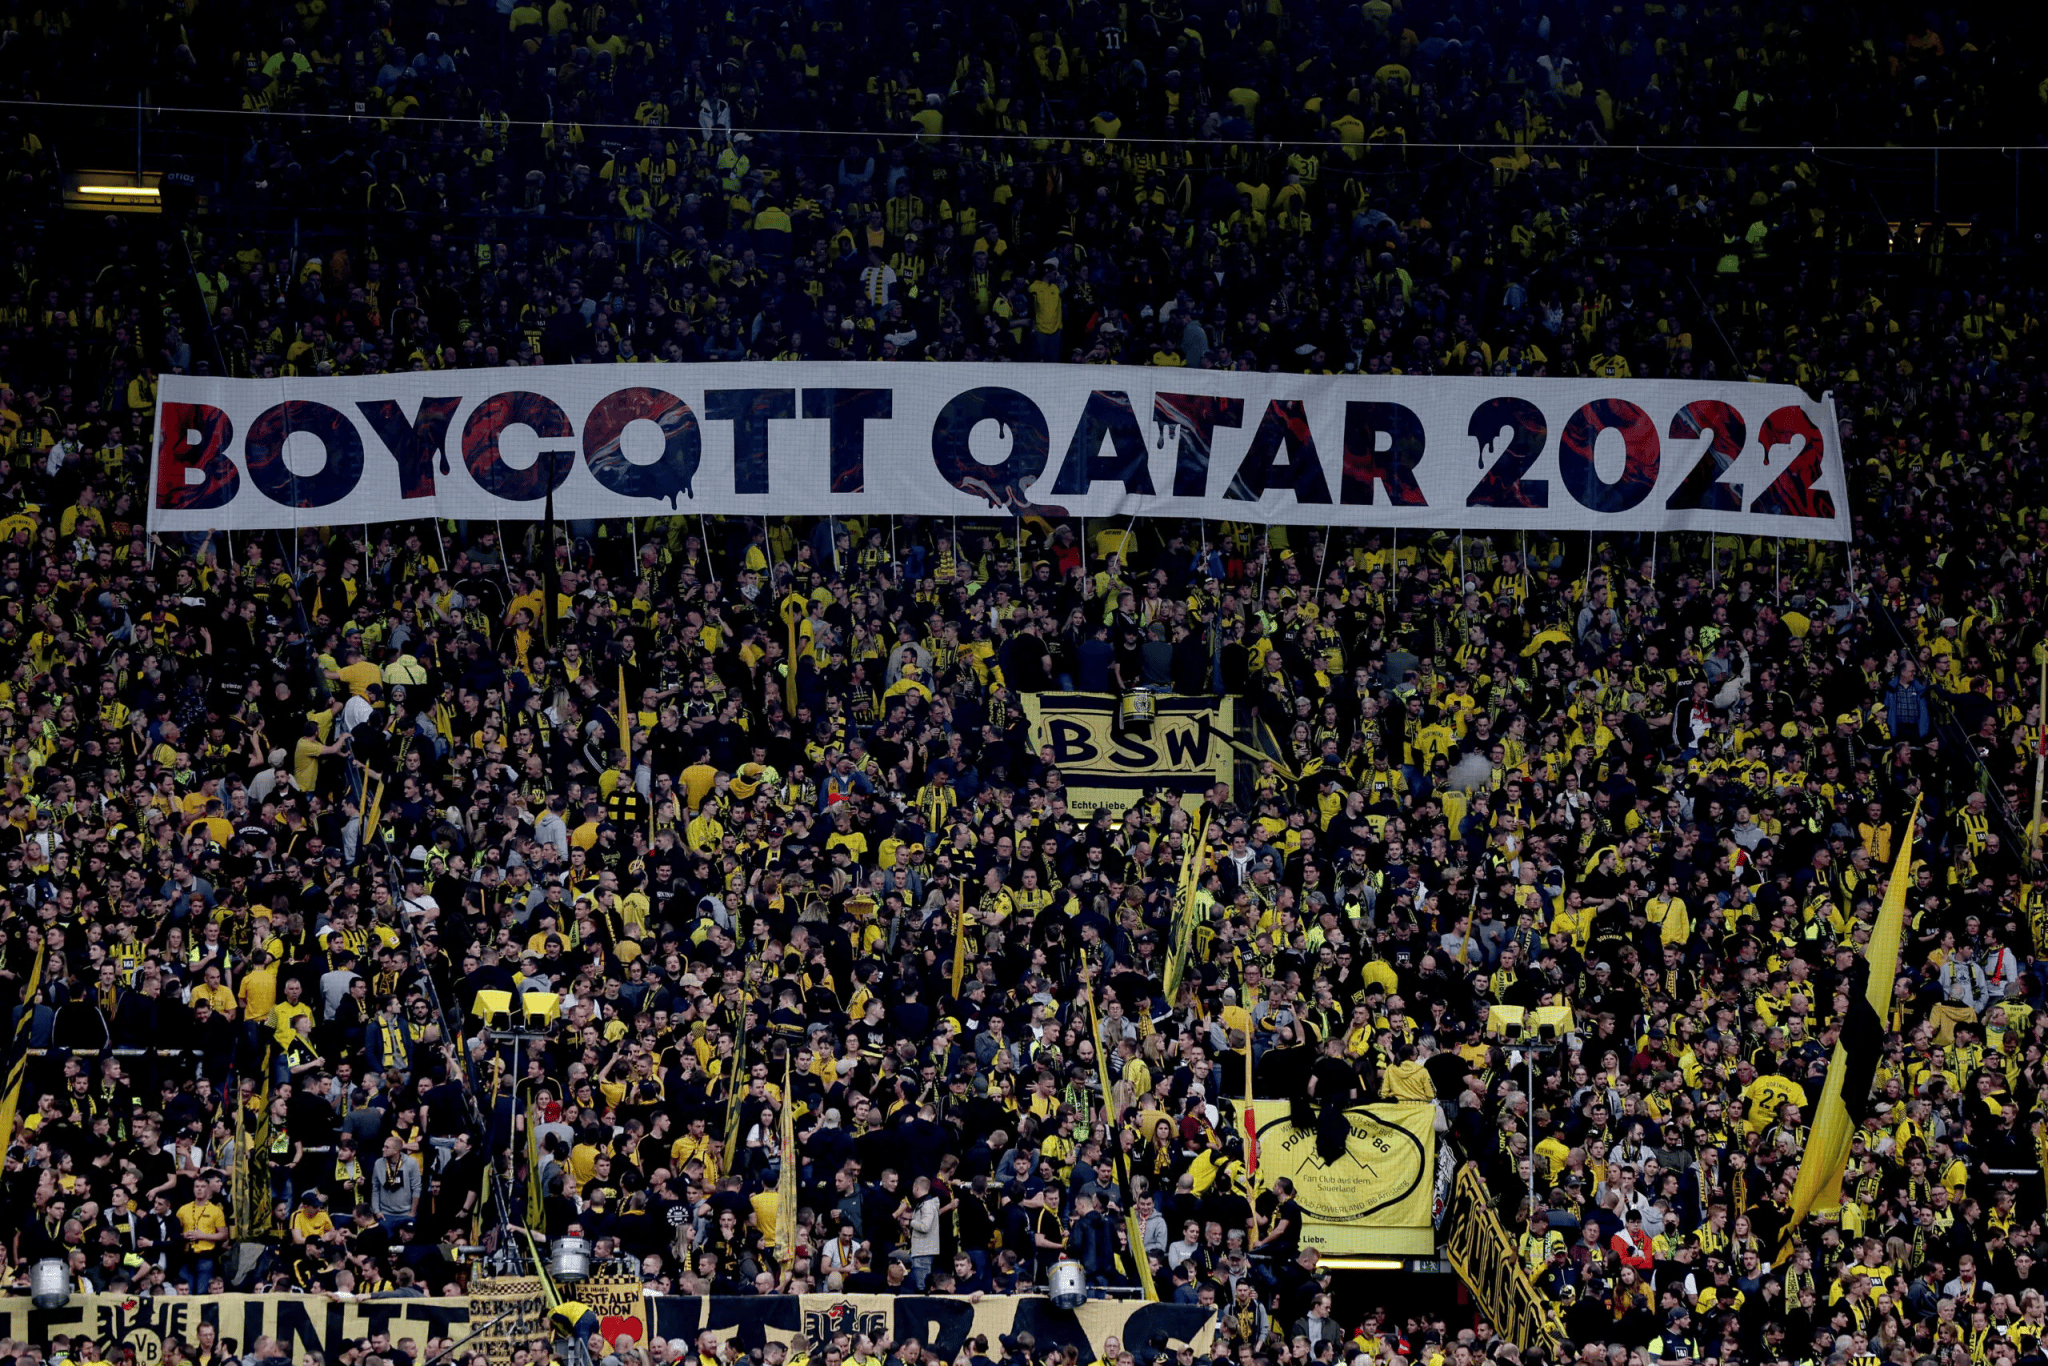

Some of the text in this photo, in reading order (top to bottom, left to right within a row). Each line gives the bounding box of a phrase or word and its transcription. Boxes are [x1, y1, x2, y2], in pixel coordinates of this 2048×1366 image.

[1300, 160, 1315, 177] 31
[156, 386, 1835, 519] BOYCOTT QATAR 2022
[1049, 713, 1210, 770] BSW
[1428, 739, 1438, 753] 4
[1071, 800, 1129, 812] Echte Liebe.
[1281, 1126, 1368, 1152] POWEND
[1303, 1174, 1317, 1183] Fan
[1318, 1174, 1335, 1184] Club
[1353, 1177, 1371, 1186] dem
[1315, 1203, 1365, 1213] POWERLAND
[1378, 1180, 1410, 1202] Arnsberg
[1317, 1184, 1356, 1194] Sauerland
[1303, 1235, 1327, 1244] Liebe.
[557, 1282, 639, 1306] WESTFALEN
[592, 1304, 631, 1316] ADION
